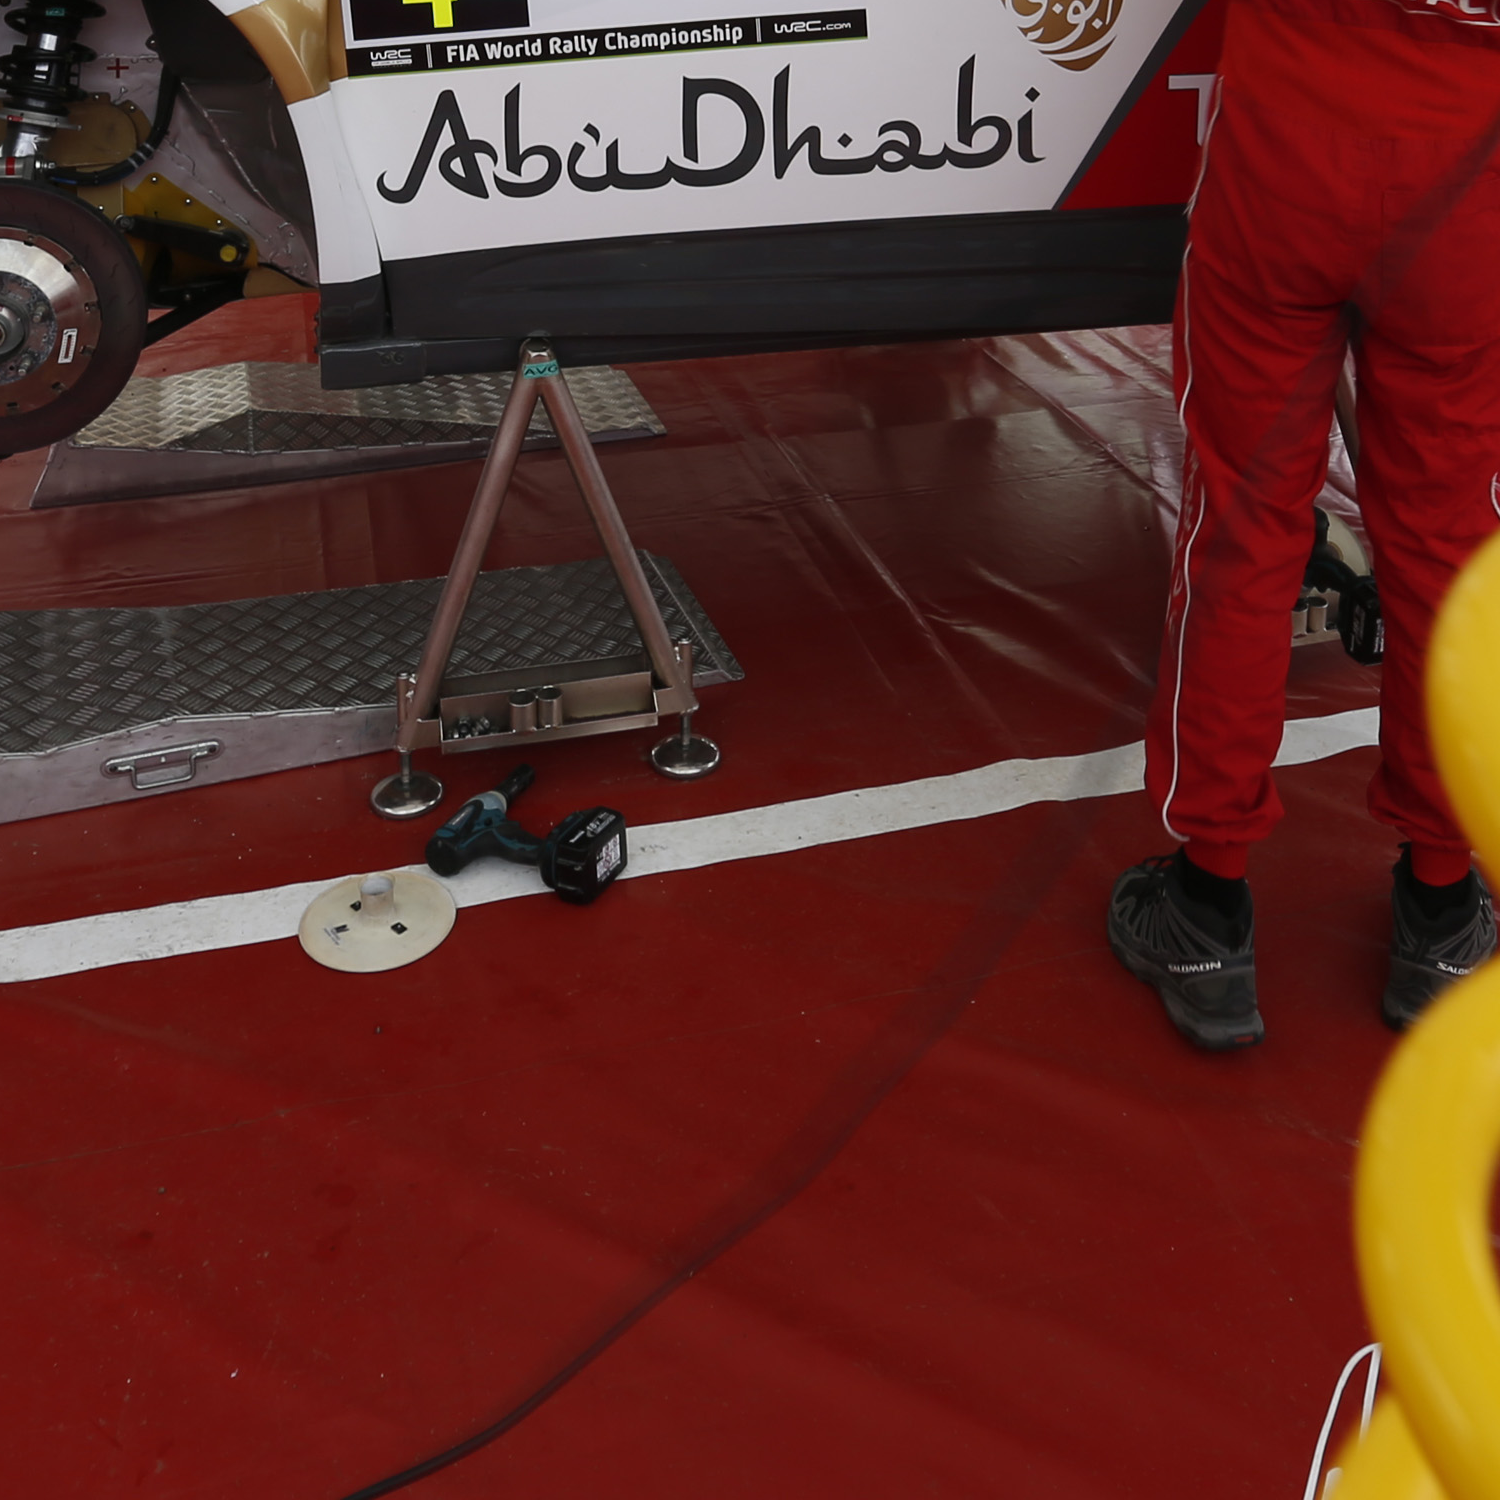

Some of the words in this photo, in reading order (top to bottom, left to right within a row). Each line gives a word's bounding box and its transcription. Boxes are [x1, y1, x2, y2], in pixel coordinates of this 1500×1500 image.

[369, 48, 412, 61] WRC
[446, 43, 481, 63] FIA
[483, 37, 543, 60] World
[549, 33, 598, 56] Rally
[604, 23, 744, 51] Championship
[1167, 960, 1222, 974] SALOMON
